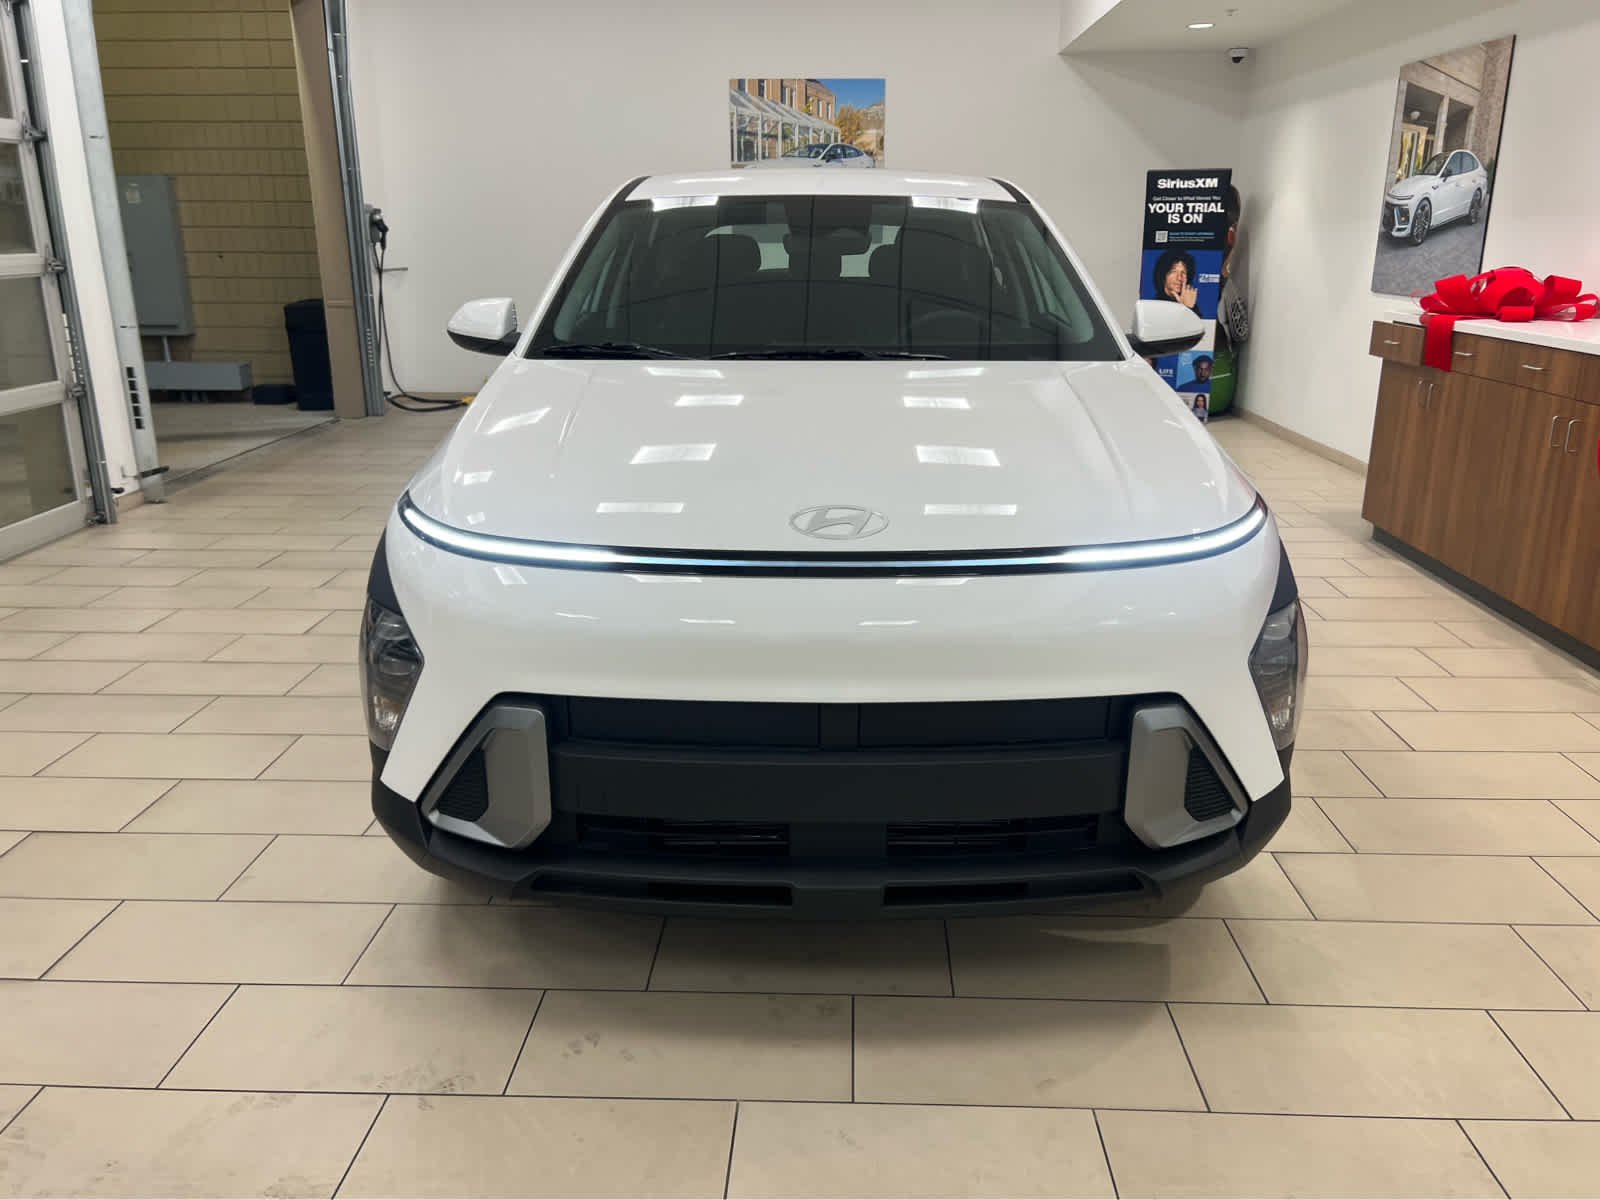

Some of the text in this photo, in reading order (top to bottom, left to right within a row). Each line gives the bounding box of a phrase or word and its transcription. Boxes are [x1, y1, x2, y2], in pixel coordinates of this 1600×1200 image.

[1157, 178, 1218, 189] SiriusXM
[1148, 202, 1224, 213] YOUR TRIAL
[1167, 213, 1203, 224] IS ON
